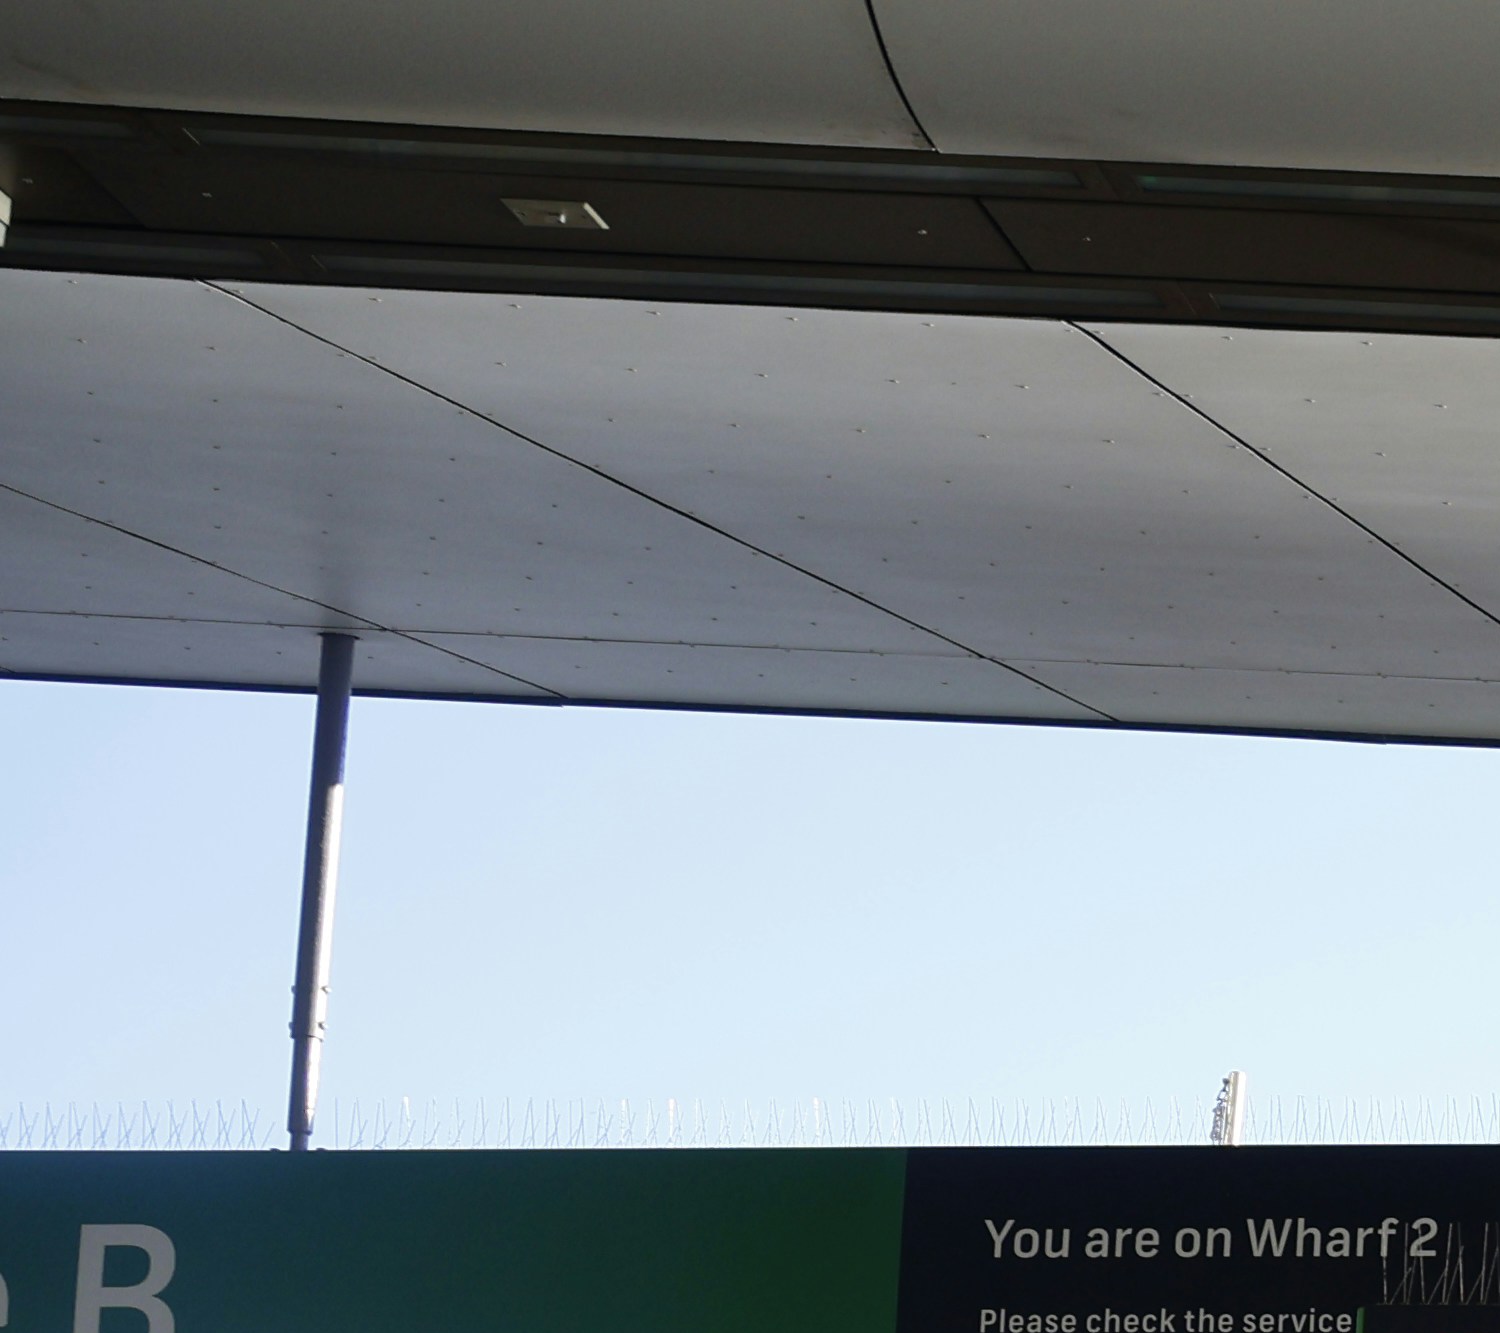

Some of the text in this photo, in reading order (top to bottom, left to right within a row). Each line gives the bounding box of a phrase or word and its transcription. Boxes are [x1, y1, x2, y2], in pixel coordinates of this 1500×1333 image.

[985, 1216, 1438, 1259] You are on Wharf 2
[979, 1306, 1353, 1333] Please check the service
